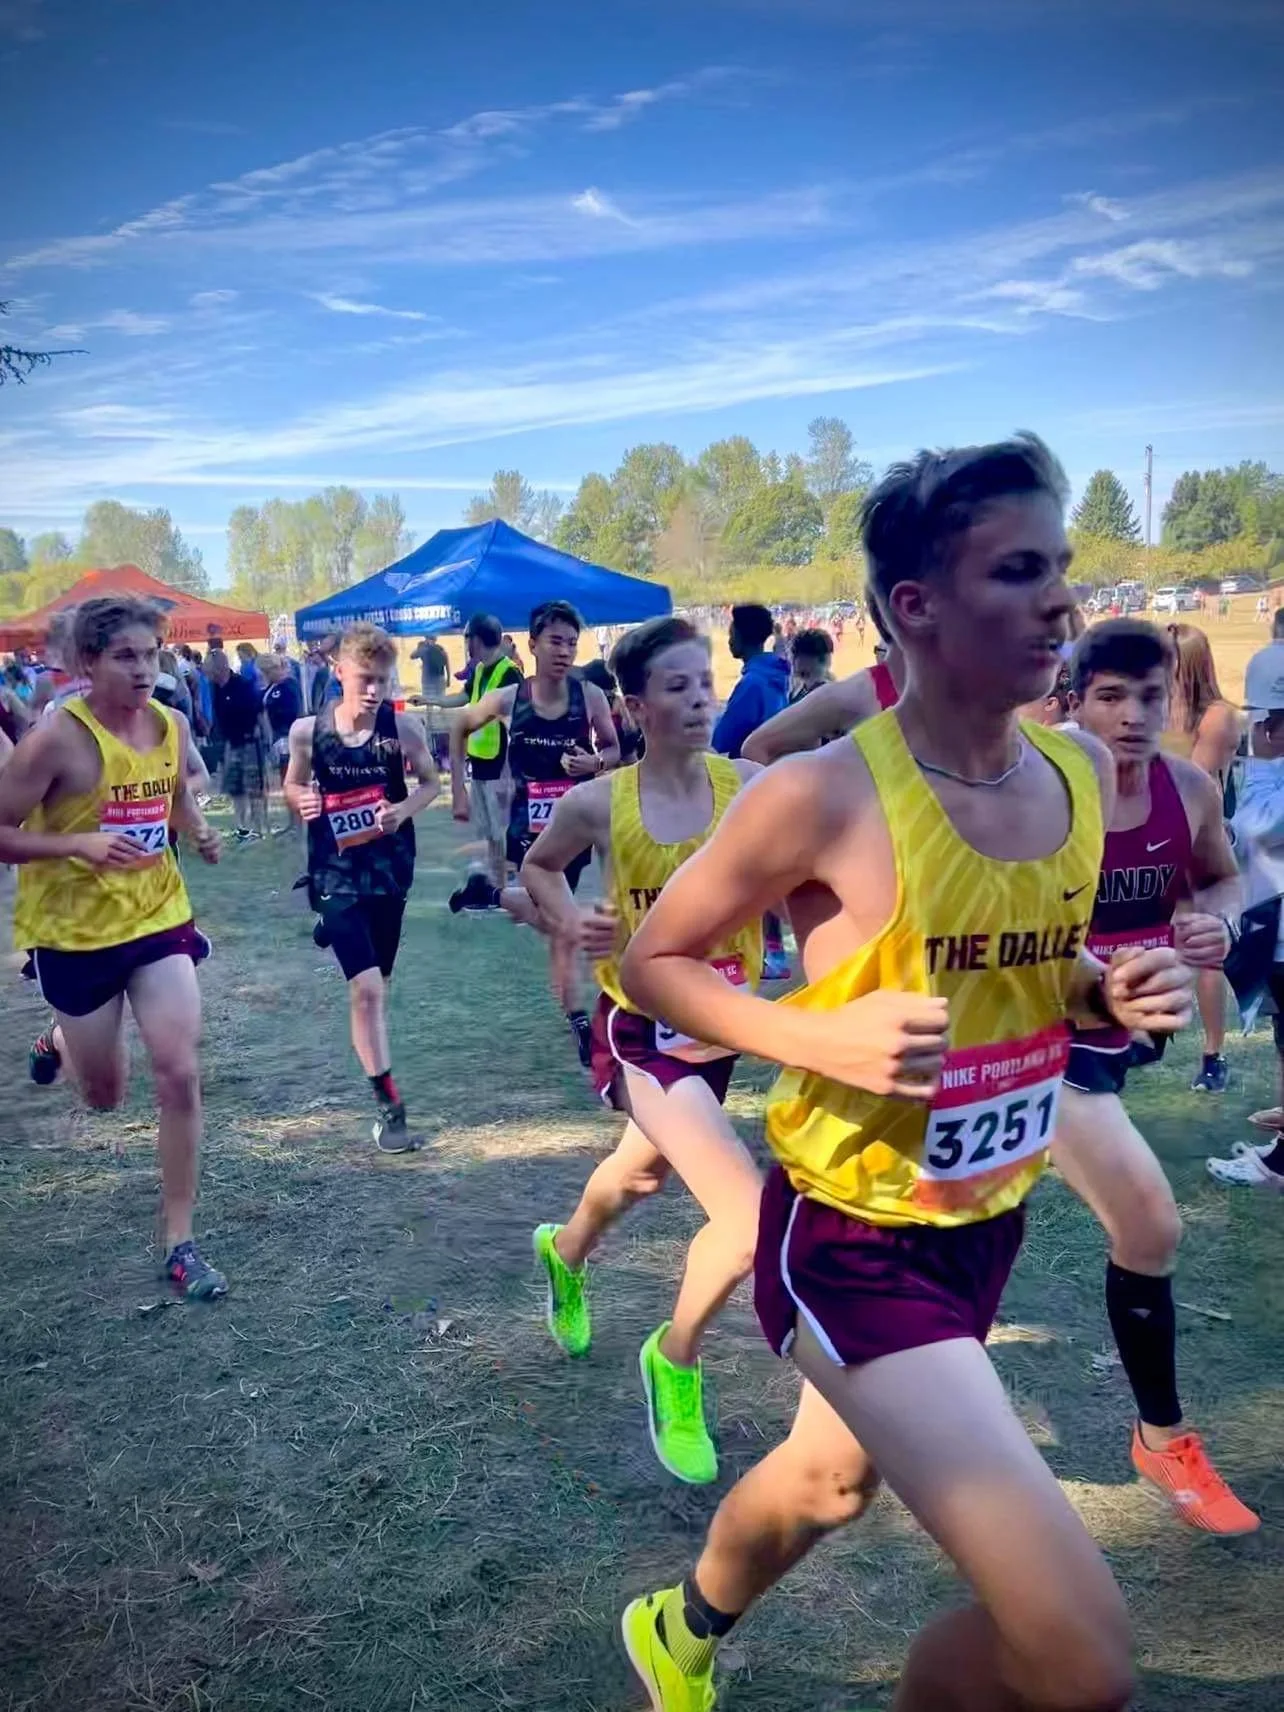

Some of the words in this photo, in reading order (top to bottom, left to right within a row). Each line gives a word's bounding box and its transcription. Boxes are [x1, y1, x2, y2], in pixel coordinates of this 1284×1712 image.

[111, 783, 140, 802] THE
[332, 809, 376, 835] 280
[530, 802, 554, 820] 27
[925, 934, 990, 974] THE
[999, 920, 1088, 968] DALLE
[942, 1065, 977, 1090] NIKE
[981, 1047, 1046, 1084] PORTLAND
[927, 1091, 1054, 1170] 3251
